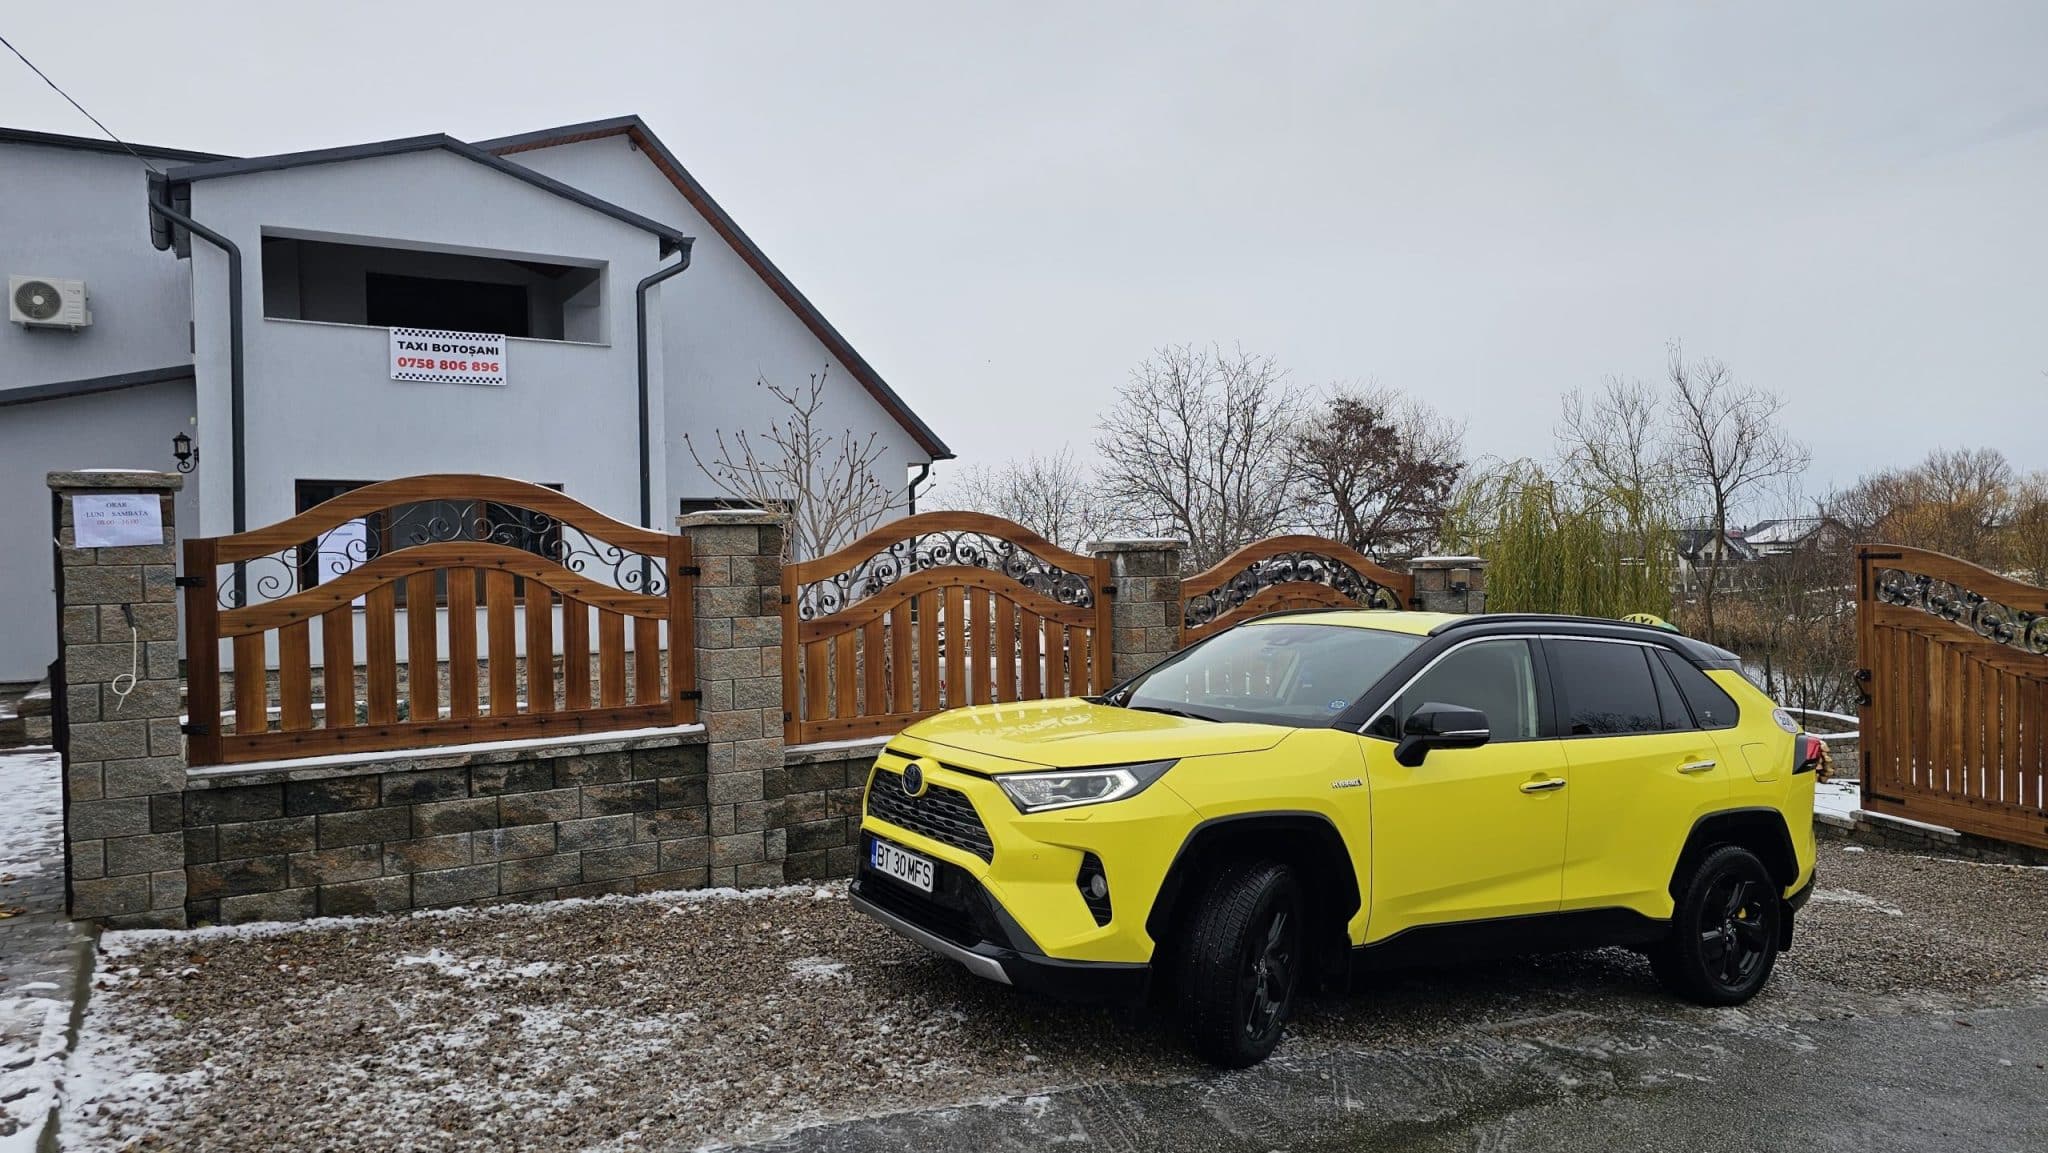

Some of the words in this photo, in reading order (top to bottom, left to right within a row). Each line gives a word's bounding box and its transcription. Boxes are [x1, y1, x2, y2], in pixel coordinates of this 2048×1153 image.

[397, 340, 428, 352] TAXI
[432, 343, 499, 357] BOTOȘANI
[397, 357, 435, 370] 0758
[439, 359, 468, 371] 806
[471, 361, 499, 373] 896
[877, 844, 891, 870] BT
[894, 852, 907, 877] 30
[907, 857, 931, 887] MFS
